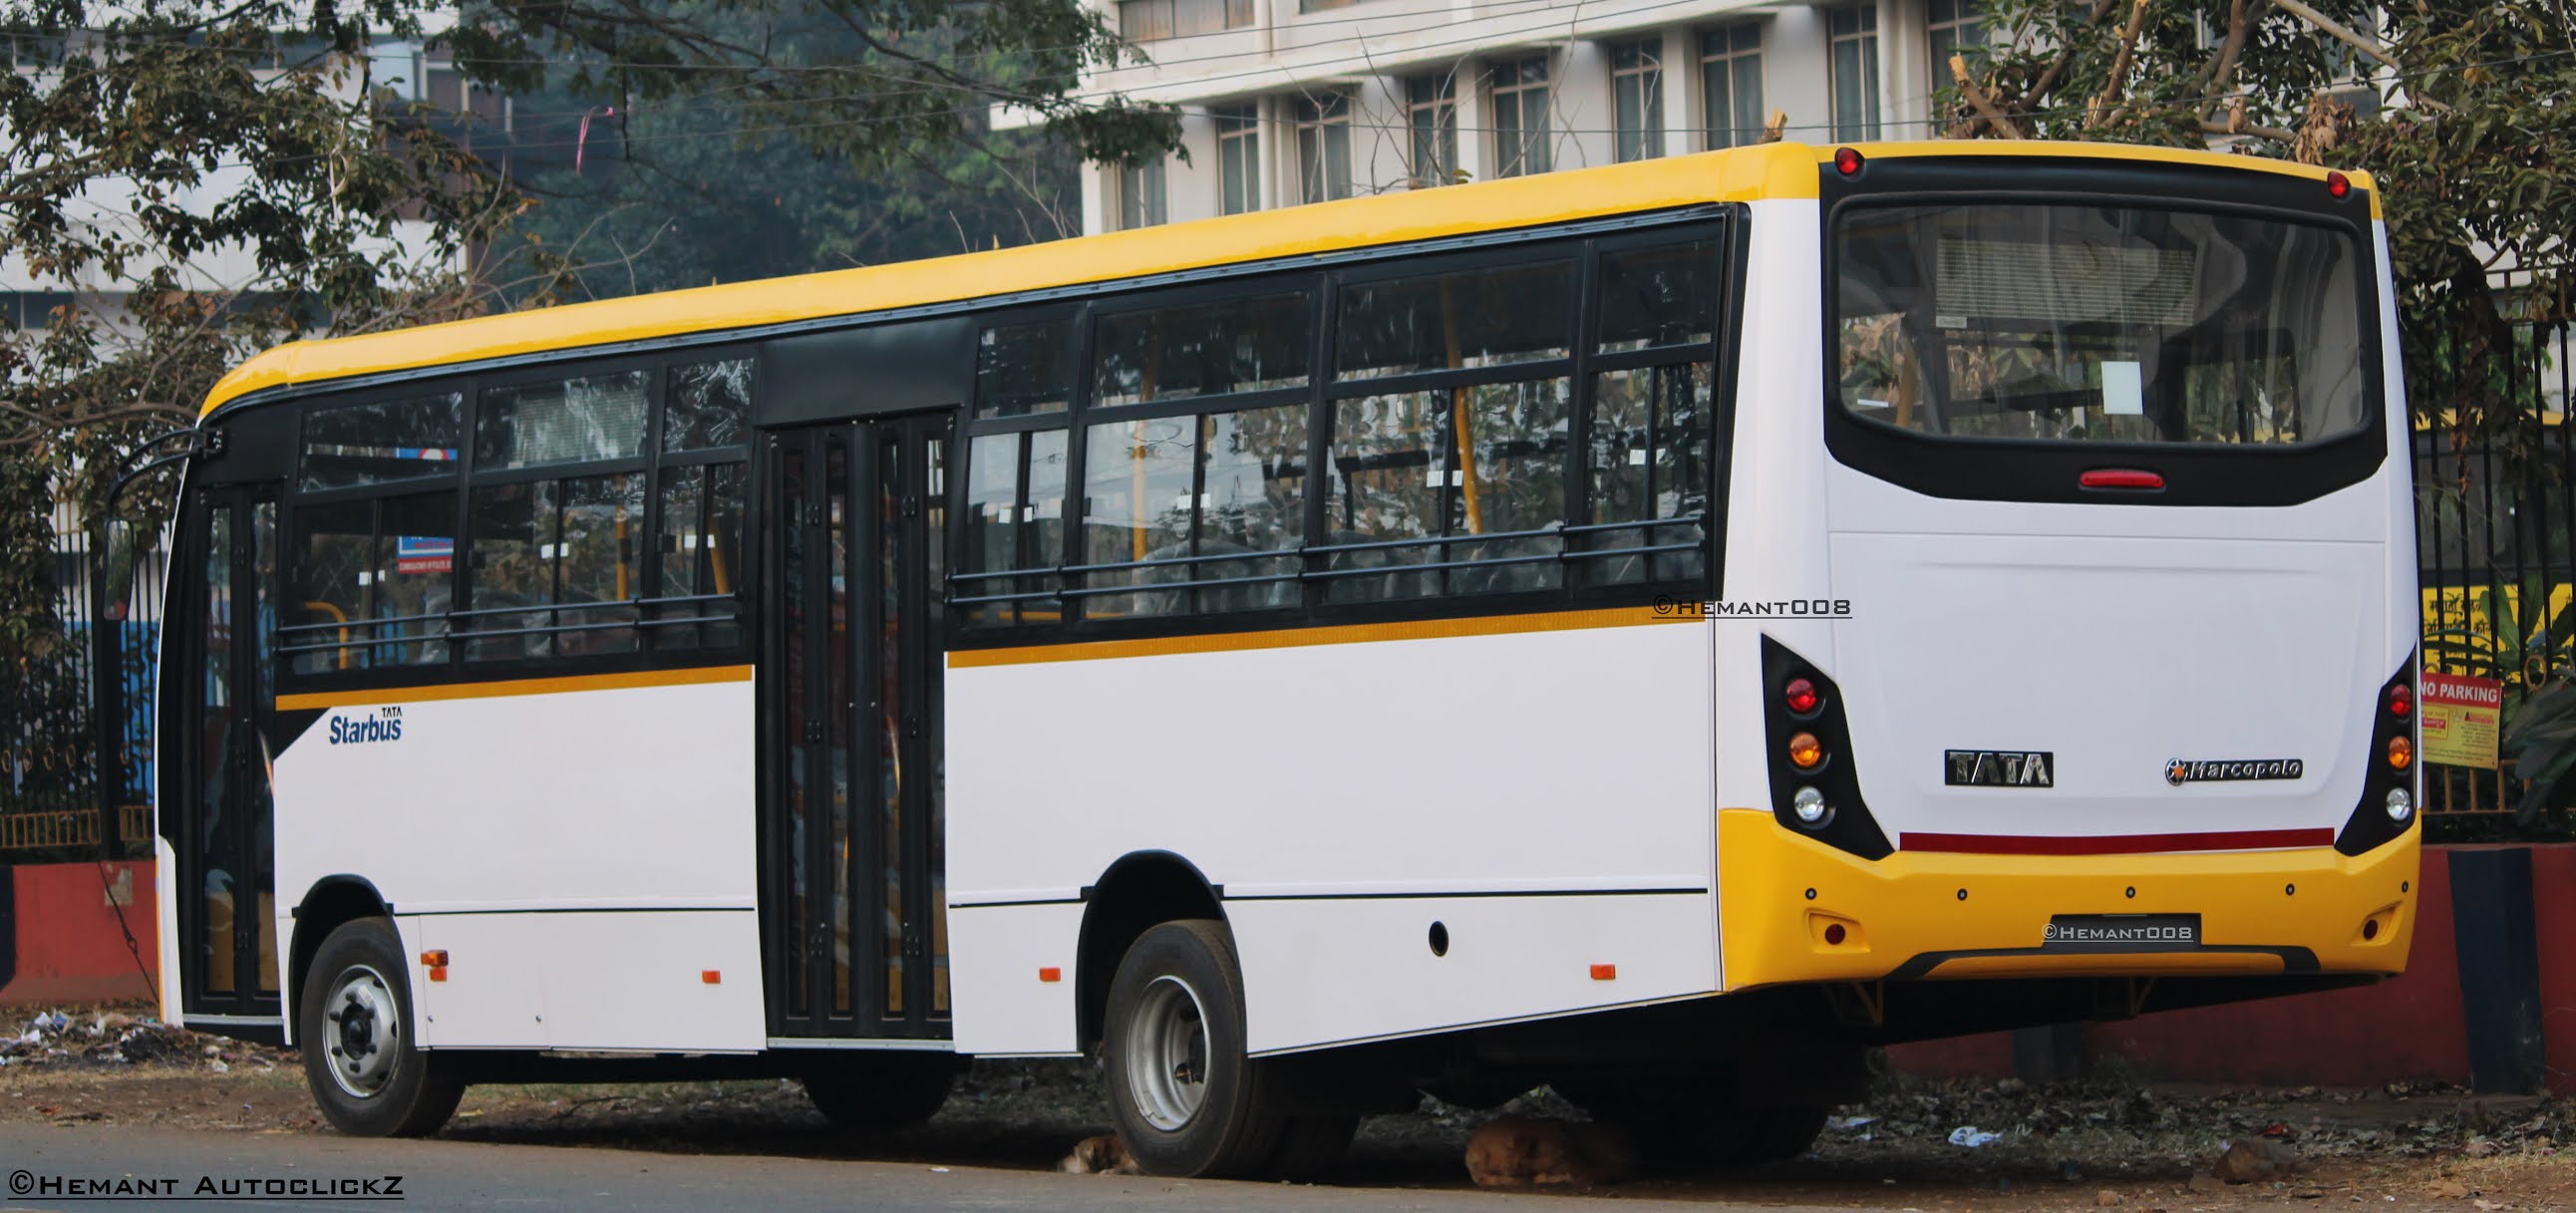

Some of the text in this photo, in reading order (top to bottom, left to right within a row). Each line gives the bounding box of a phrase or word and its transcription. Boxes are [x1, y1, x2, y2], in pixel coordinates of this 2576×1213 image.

[2439, 683, 2498, 703] PARKING
[382, 706, 403, 718] TATA
[329, 714, 402, 746] Starbus
[1949, 752, 2051, 785] TATA
[2189, 759, 2301, 779] Marcopolo
